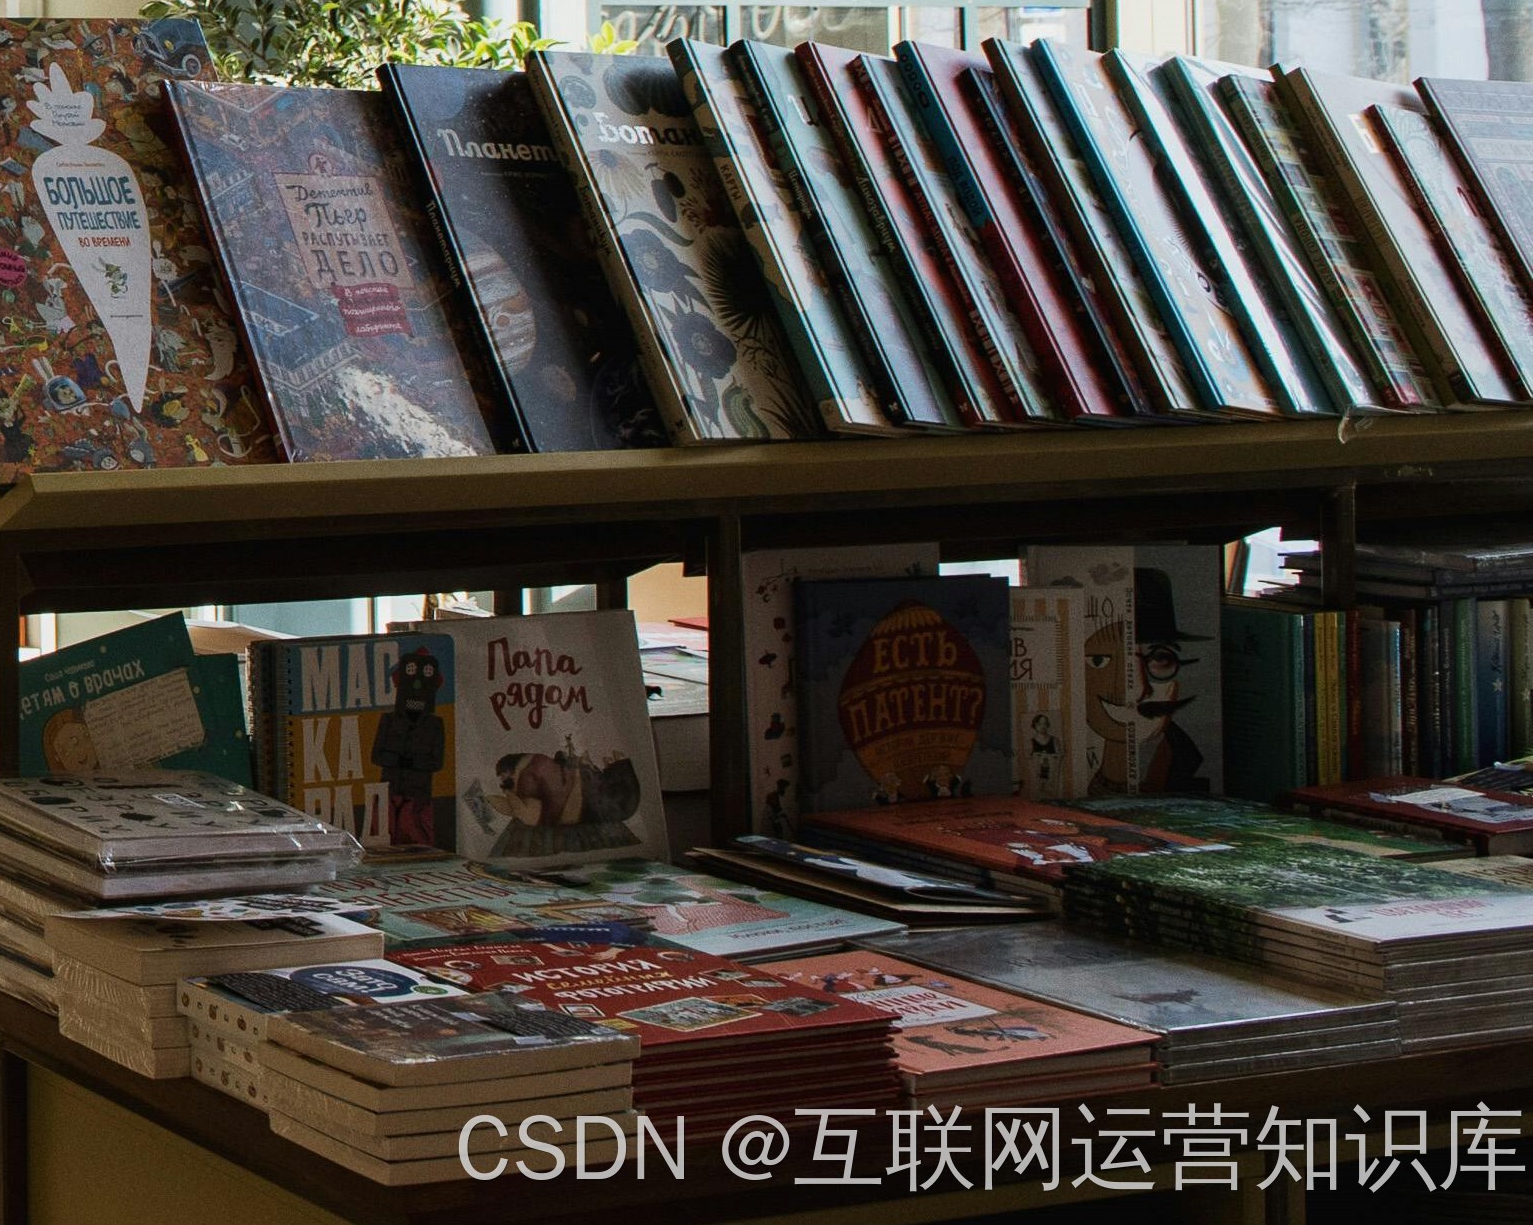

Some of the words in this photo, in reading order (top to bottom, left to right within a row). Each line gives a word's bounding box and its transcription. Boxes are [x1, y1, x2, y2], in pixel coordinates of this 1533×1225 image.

[436, 127, 557, 164] Планет
[42, 175, 136, 209] БОЛЬШОЕ
[286, 181, 374, 203] Детектив
[719, 163, 743, 202] КАРТЫ
[56, 209, 142, 232] ПУТЕШЕСТВИЕ
[304, 202, 368, 229] Пьер
[78, 236, 90, 248] ВО
[92, 235, 132, 249] ВРЕМЕНИ
[302, 230, 390, 250] РАСПУТЫВАЕТ
[311, 249, 400, 280] ДЕЛО
[486, 636, 583, 682] Папа
[872, 630, 958, 675] ЕСТЬ
[83, 659, 145, 696] врачах
[489, 679, 594, 732] рядом
[846, 683, 985, 741] ПАТЕНТ?
[301, 713, 364, 782] КА
[510, 956, 662, 984] ИСТОРИЯ
[552, 975, 718, 1003] ФОТОГРАФИЙ
